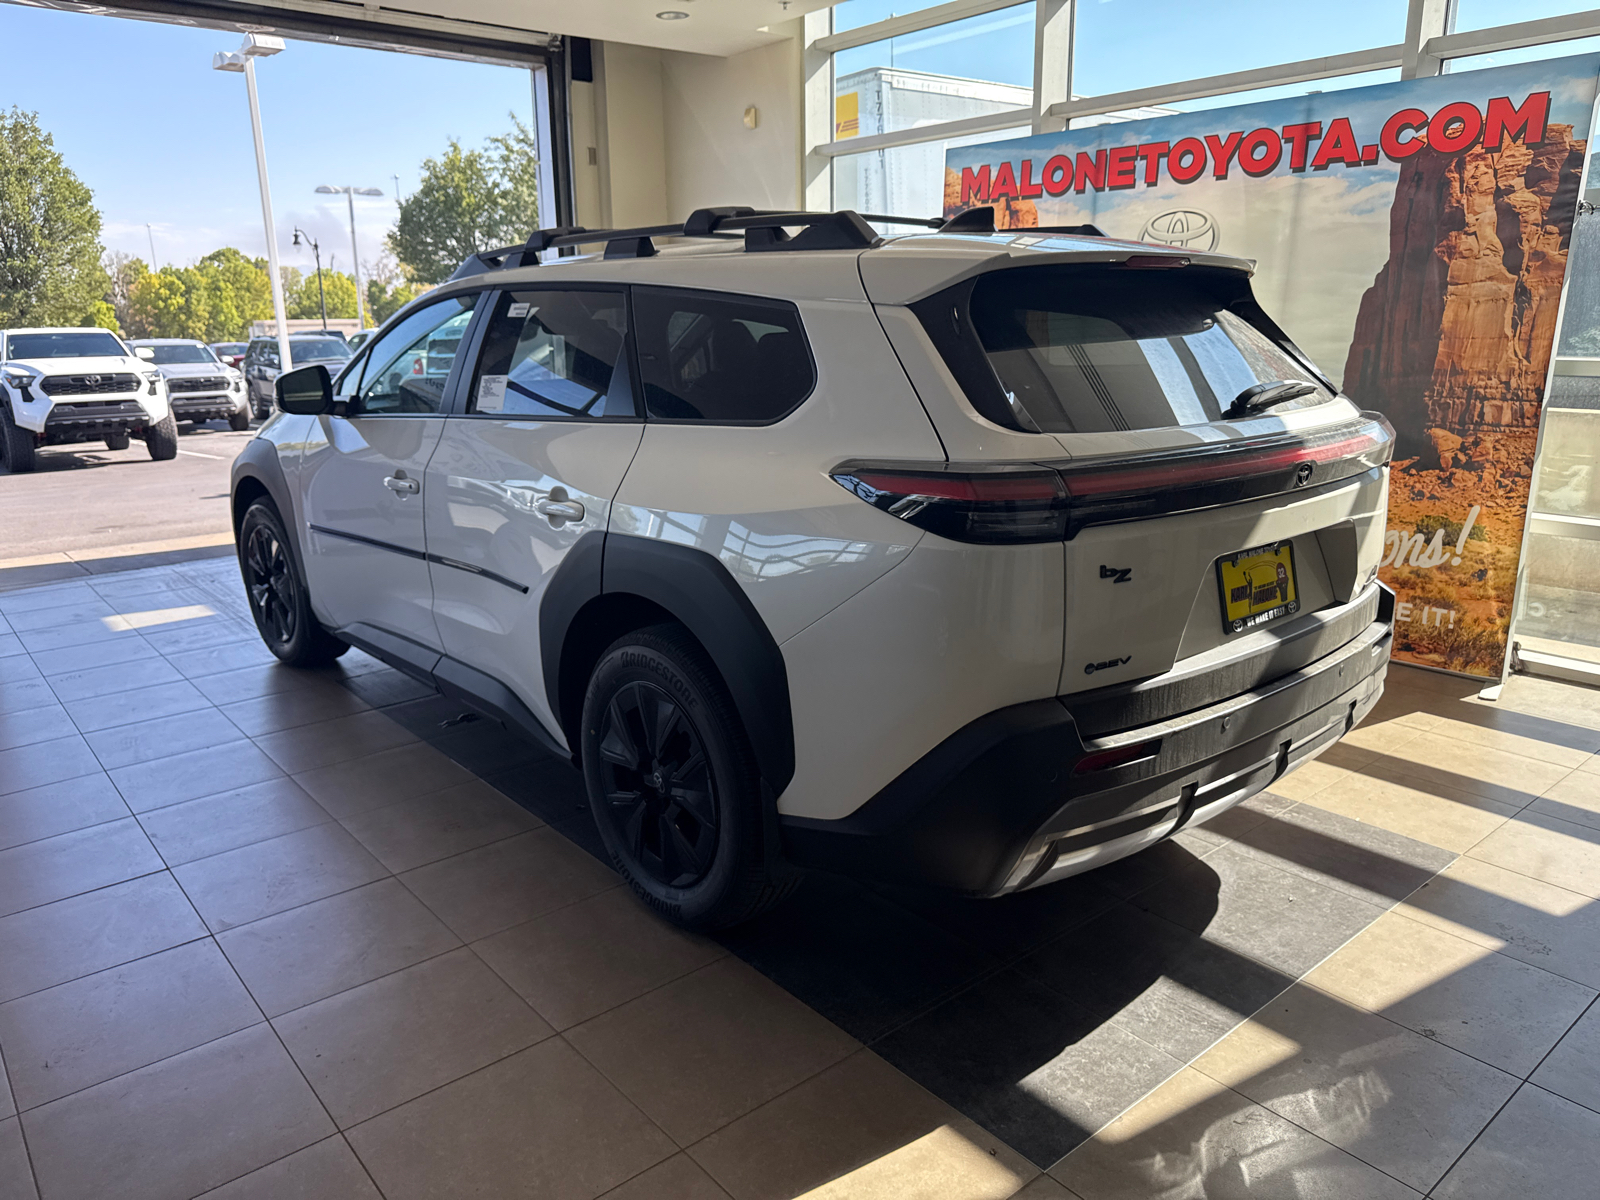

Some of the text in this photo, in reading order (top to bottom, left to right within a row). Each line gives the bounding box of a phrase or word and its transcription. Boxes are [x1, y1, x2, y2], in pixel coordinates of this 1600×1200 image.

[960, 90, 1552, 204] MALONETOYOTA.COM
[1277, 567, 1286, 579] 32
[1246, 617, 1256, 628] WE
[1255, 611, 1269, 625] MAKE
[1274, 606, 1285, 618] EASY
[1422, 606, 1456, 629] IT!
